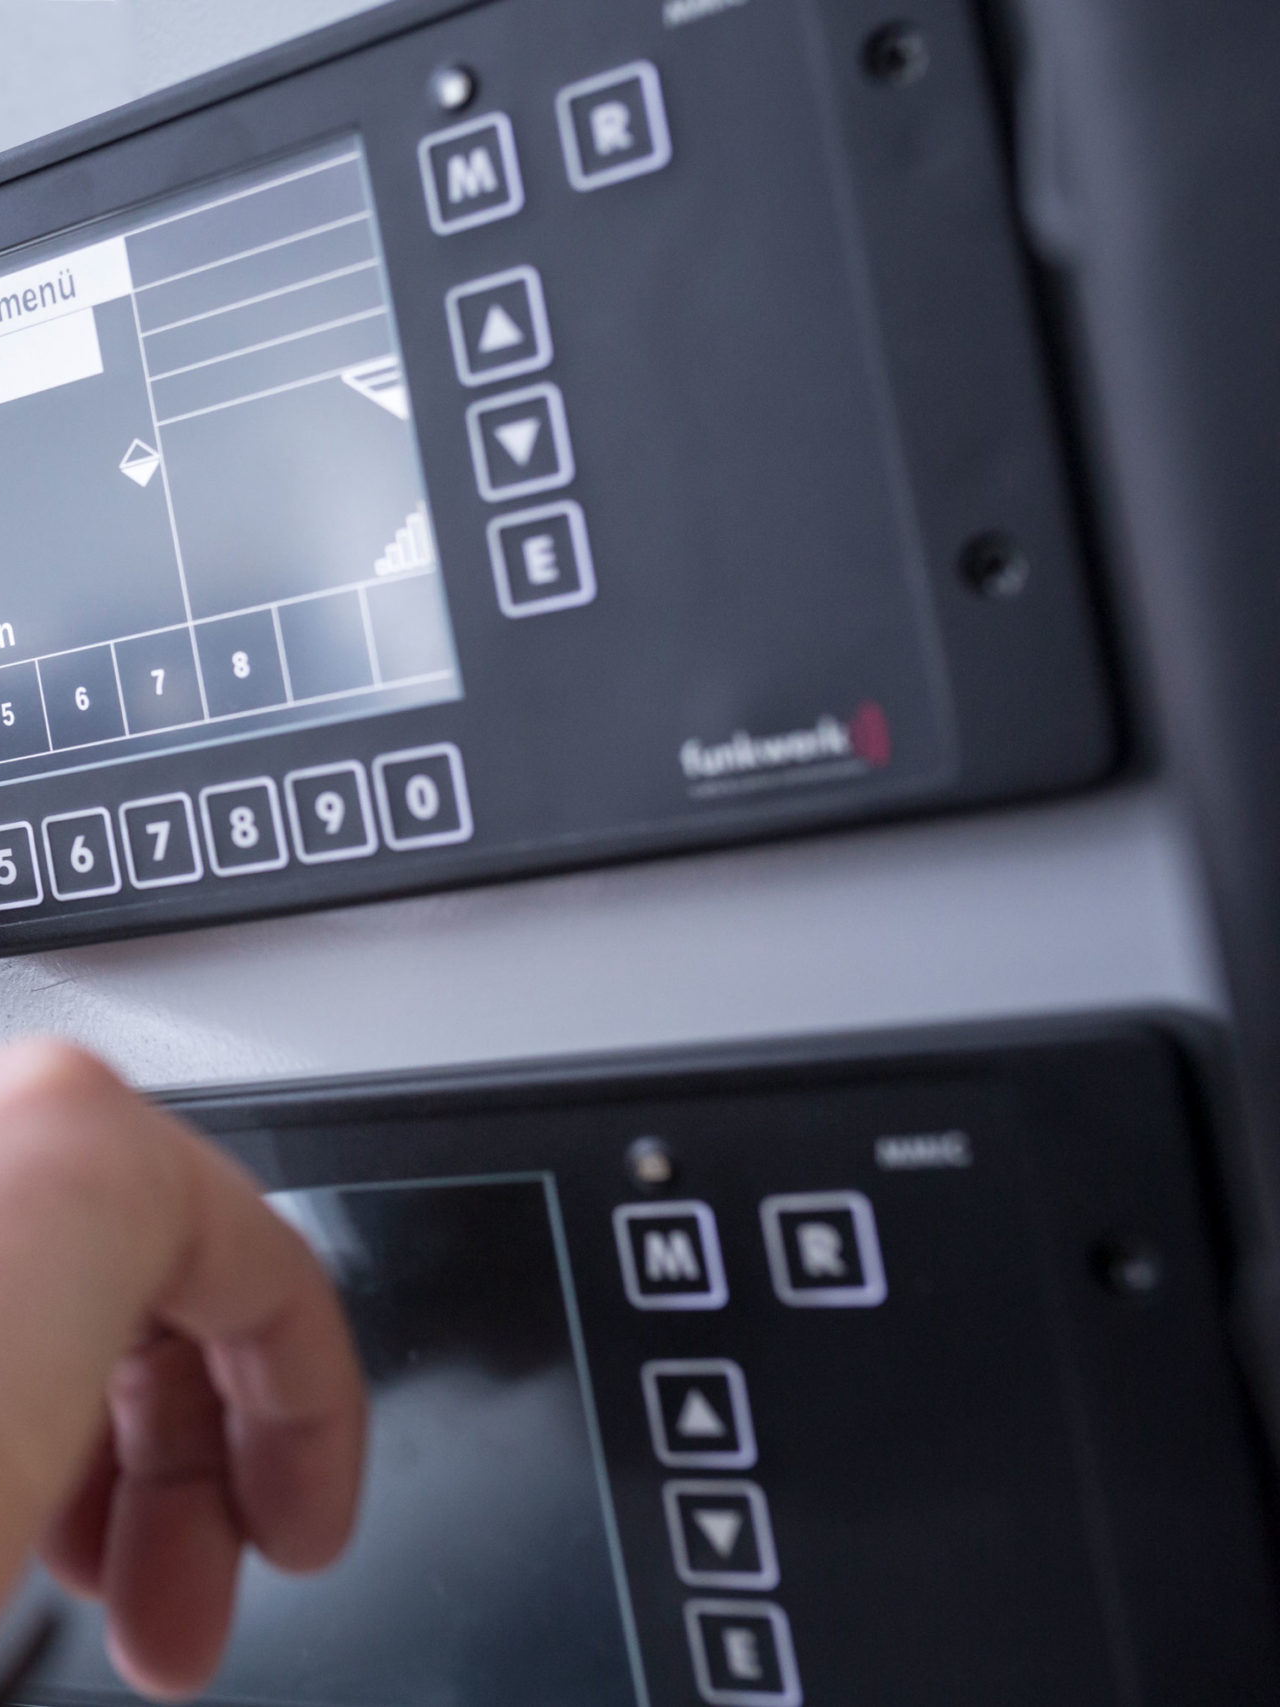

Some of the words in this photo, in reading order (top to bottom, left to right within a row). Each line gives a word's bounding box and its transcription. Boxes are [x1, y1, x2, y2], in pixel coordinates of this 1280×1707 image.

[589, 100, 636, 157] R
[447, 146, 498, 205] M
[521, 534, 558, 587] E
[0, 702, 15, 727] 5
[74, 686, 90, 711] 6
[150, 669, 166, 696] 7
[232, 650, 251, 678] 8
[70, 834, 95, 874] 6
[145, 820, 171, 862] 7
[229, 806, 260, 849] 8
[315, 791, 346, 835] 9
[404, 773, 440, 822] 0
[643, 1229, 700, 1281] M
[794, 1221, 846, 1277] R
[722, 1627, 761, 1680] E
